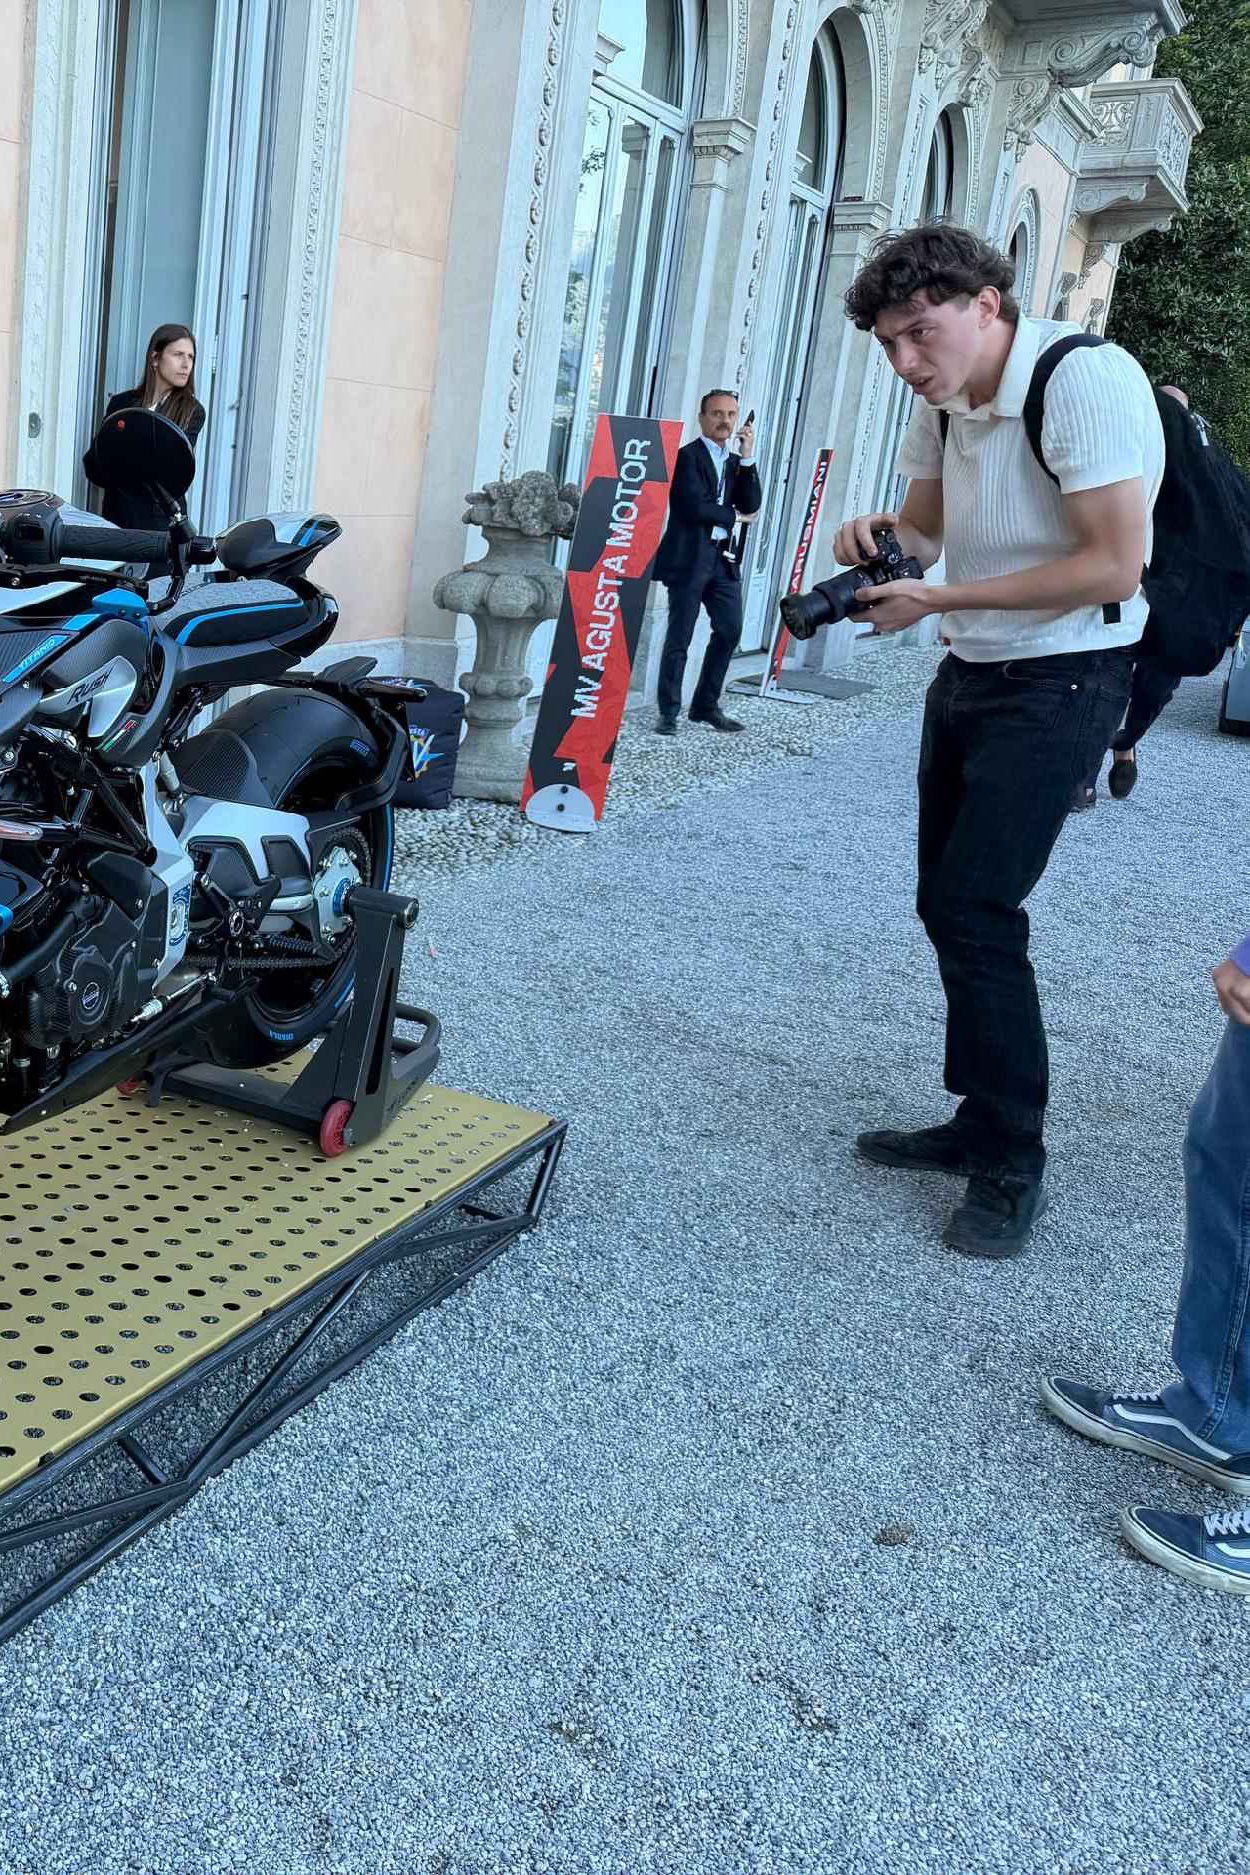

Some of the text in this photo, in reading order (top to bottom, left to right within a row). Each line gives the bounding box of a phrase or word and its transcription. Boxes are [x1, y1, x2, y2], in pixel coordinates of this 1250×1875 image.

[570, 438, 652, 719] MV AGUSTA MOTOR
[18, 639, 56, 670] TITANIO
[66, 666, 115, 705] RUSH
